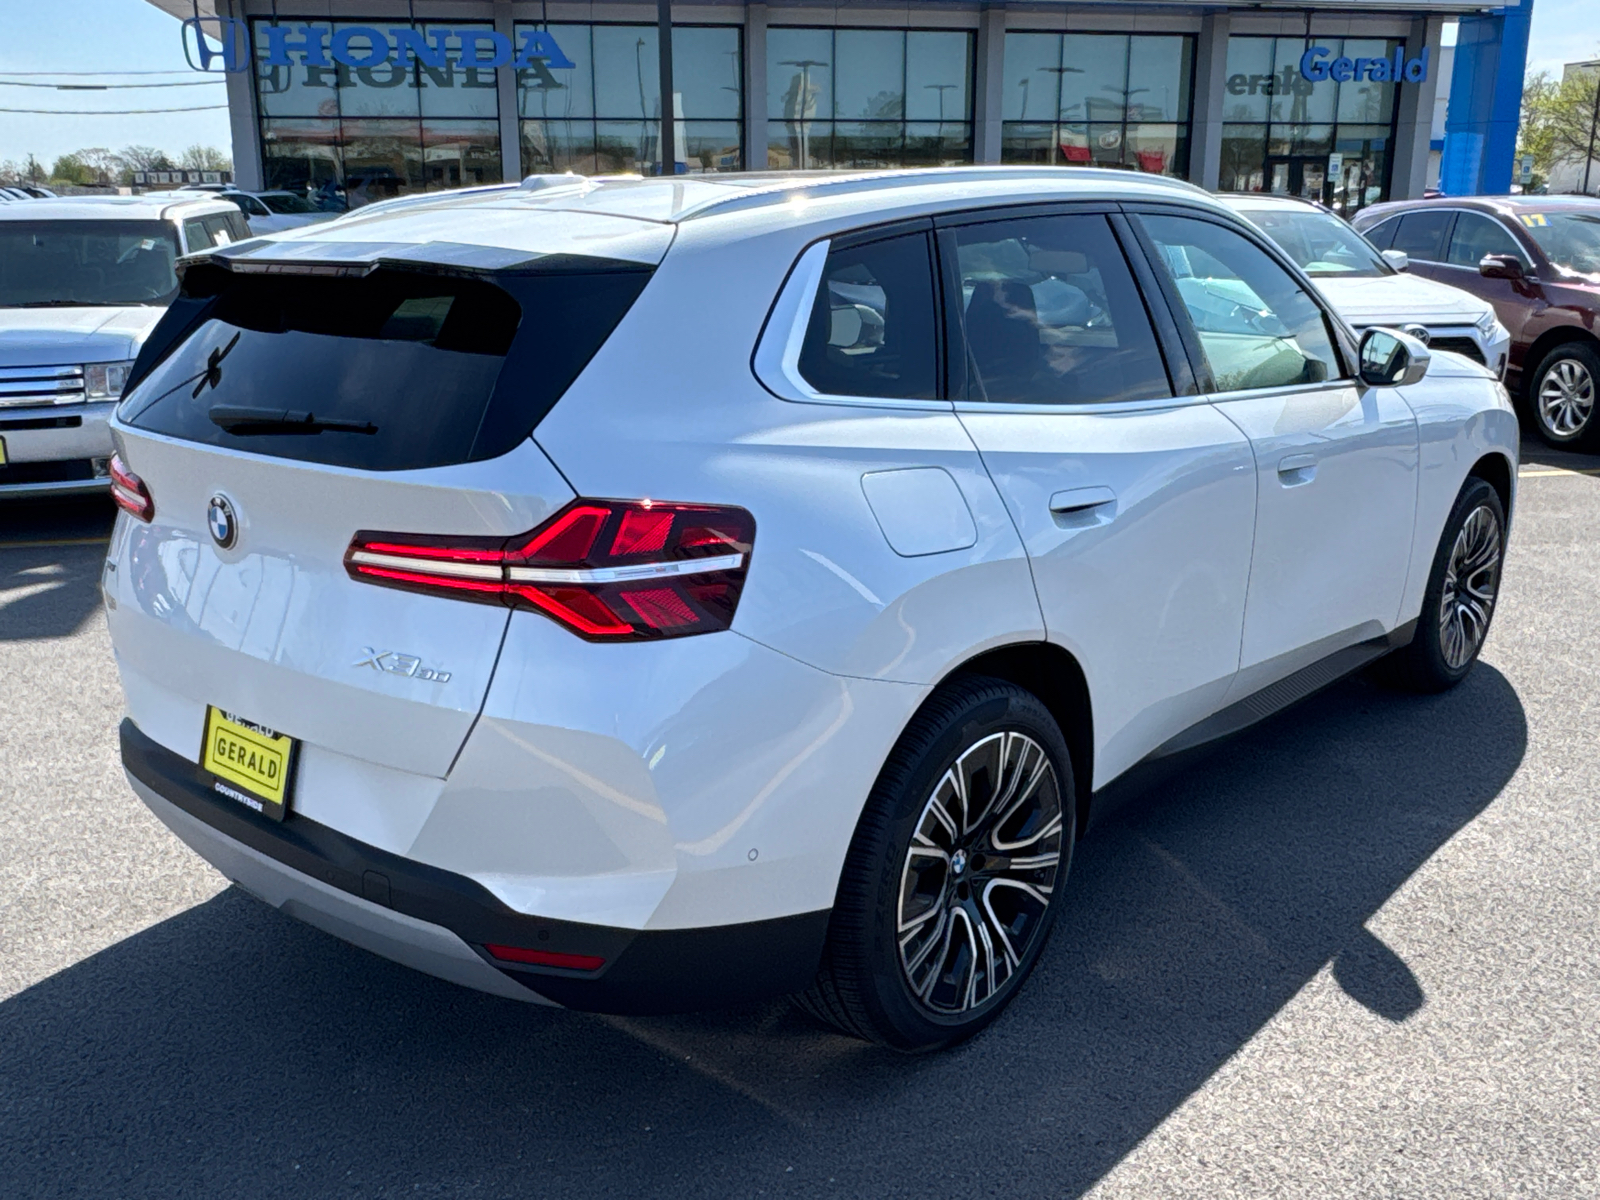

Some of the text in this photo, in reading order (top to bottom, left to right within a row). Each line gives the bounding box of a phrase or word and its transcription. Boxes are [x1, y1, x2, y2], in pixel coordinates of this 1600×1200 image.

[261, 27, 576, 69] HONDA
[1301, 46, 1429, 83] Gerald
[351, 646, 421, 678] X3
[217, 737, 277, 779] GERALD
